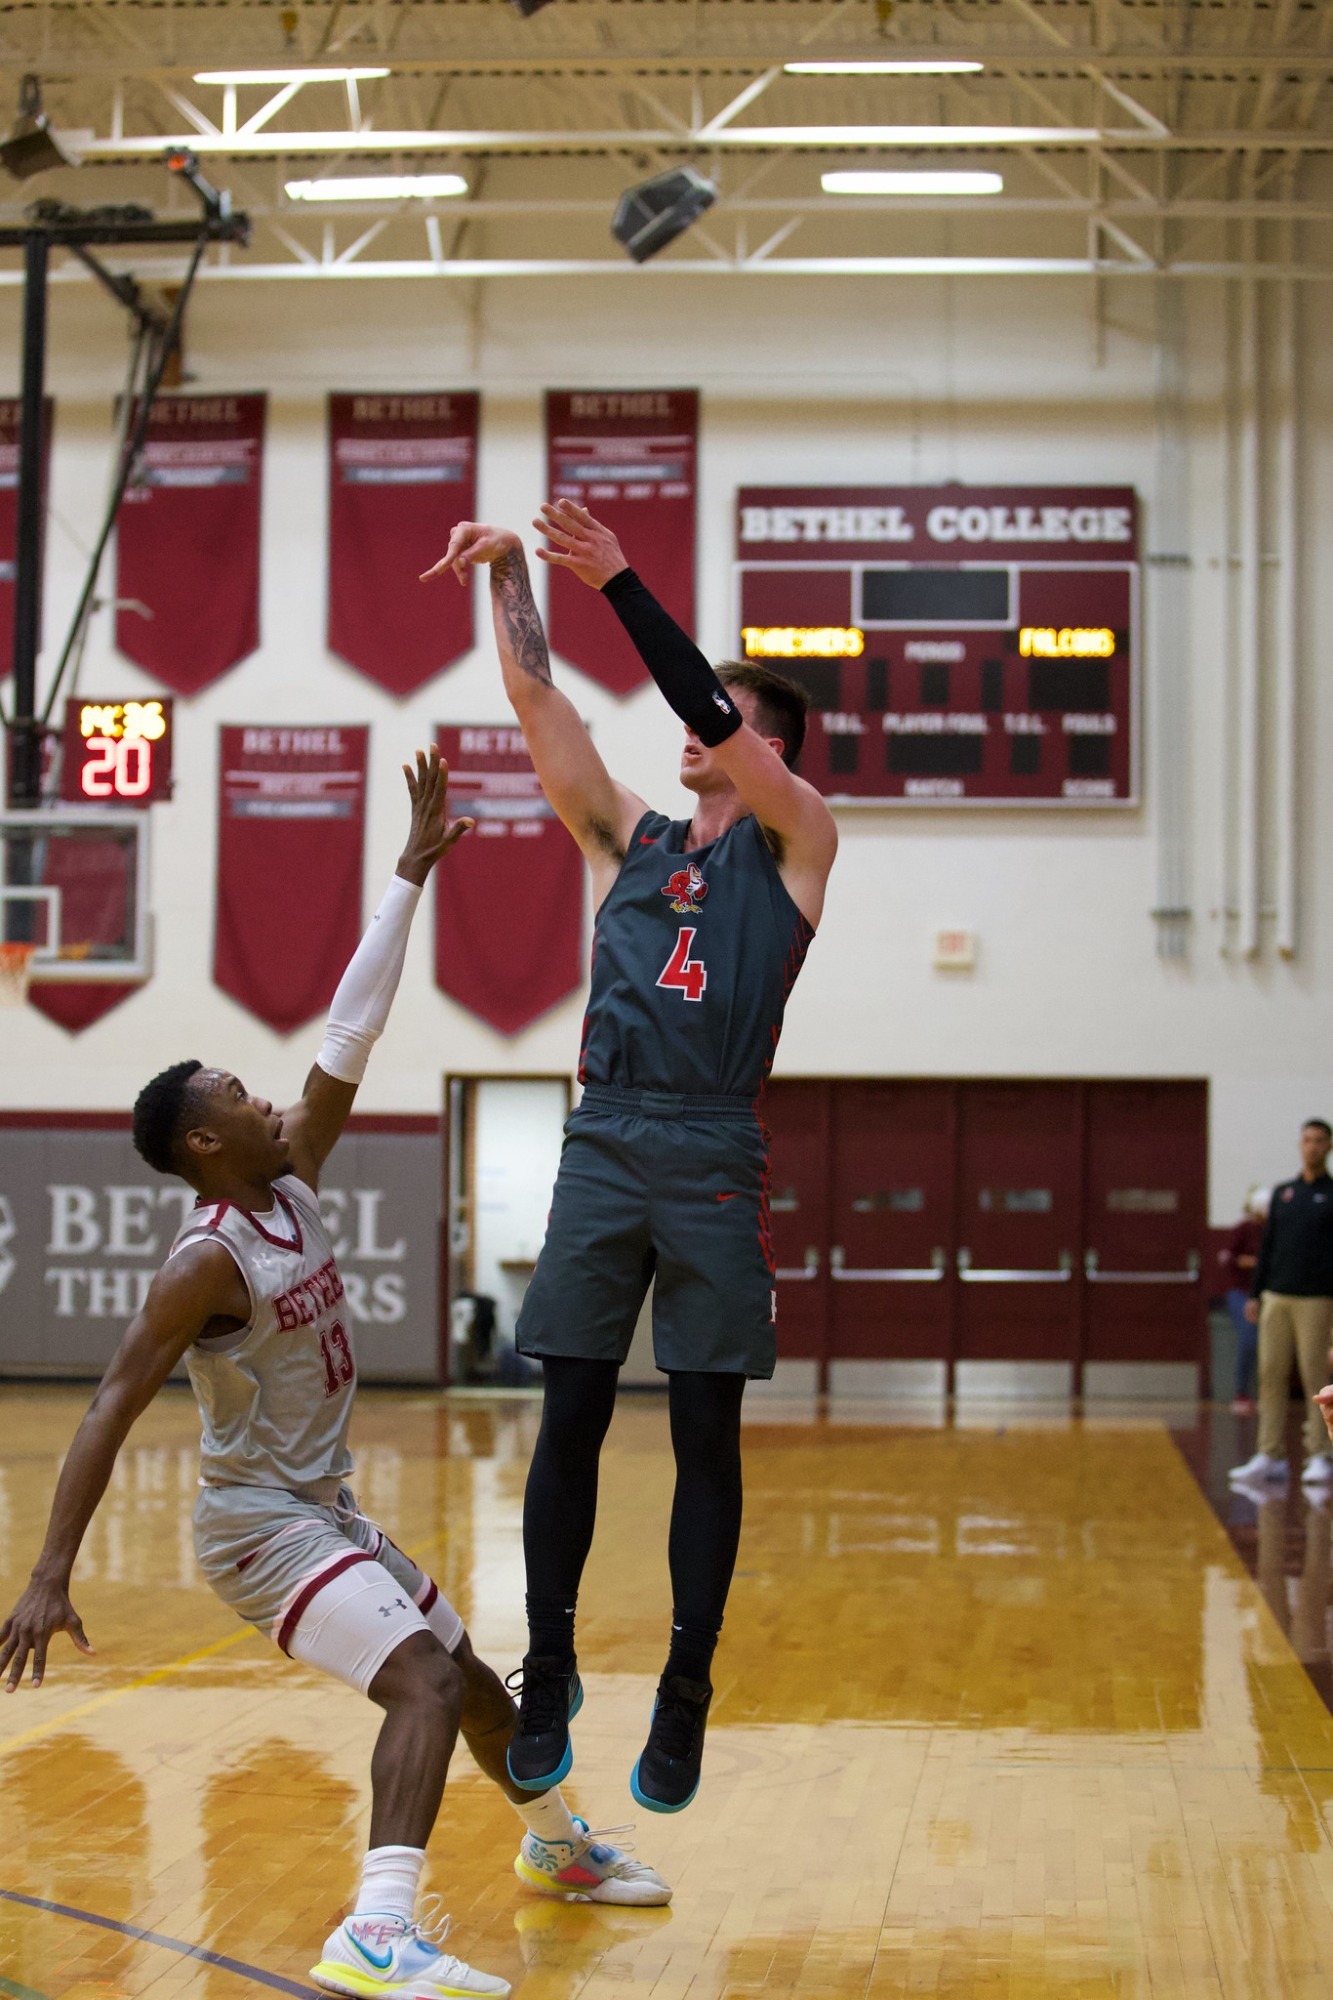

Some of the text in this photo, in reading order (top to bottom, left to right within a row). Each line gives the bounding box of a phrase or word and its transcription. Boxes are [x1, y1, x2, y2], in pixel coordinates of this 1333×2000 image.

[742, 506, 1131, 542] BETHEL COLLEGE
[82, 736, 151, 796] 20
[243, 729, 347, 755] BETHEL
[656, 926, 707, 1002] 4
[319, 1318, 356, 1399] 13
